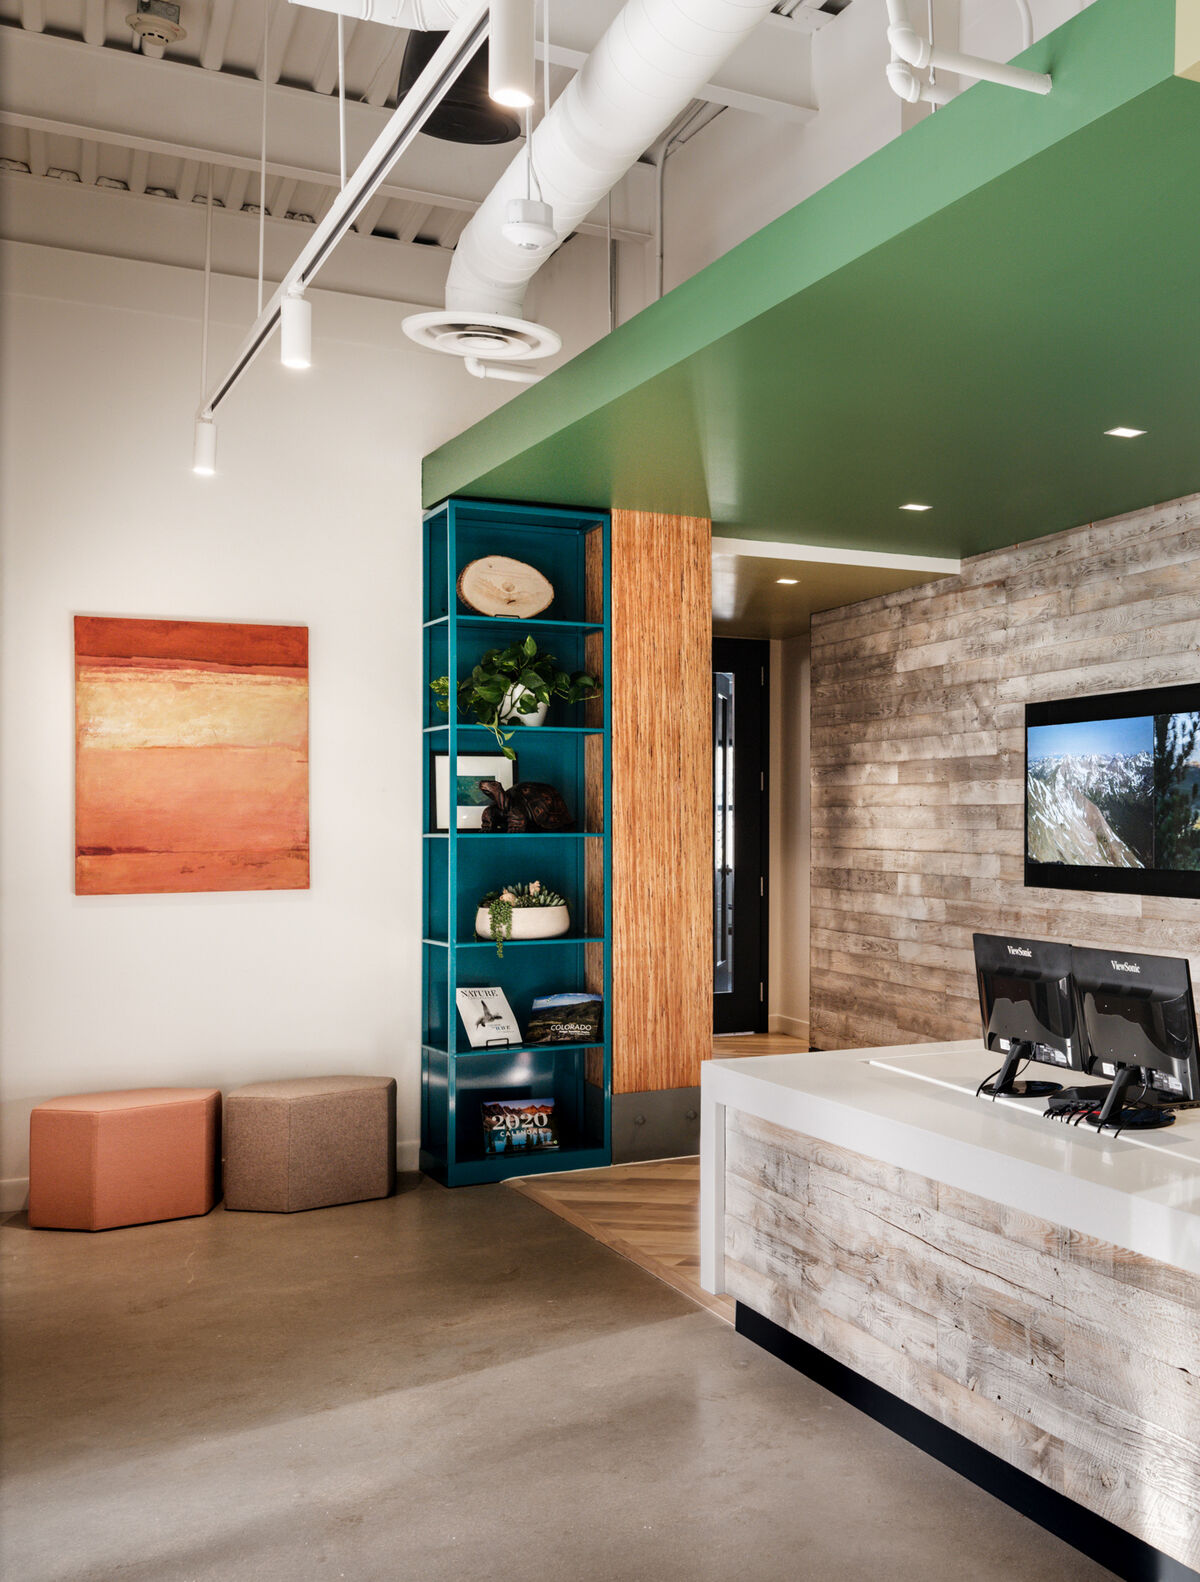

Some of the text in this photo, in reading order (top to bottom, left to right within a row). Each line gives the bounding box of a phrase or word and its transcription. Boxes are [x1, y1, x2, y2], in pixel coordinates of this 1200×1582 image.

[1007, 945, 1032, 958] ViewSonic
[1111, 960, 1141, 974] ViewSonic
[460, 989, 499, 998] NATURE
[550, 1023, 592, 1031] COLORADO
[491, 1112, 548, 1131] 2020
[499, 1128, 544, 1137] CALENDAR
